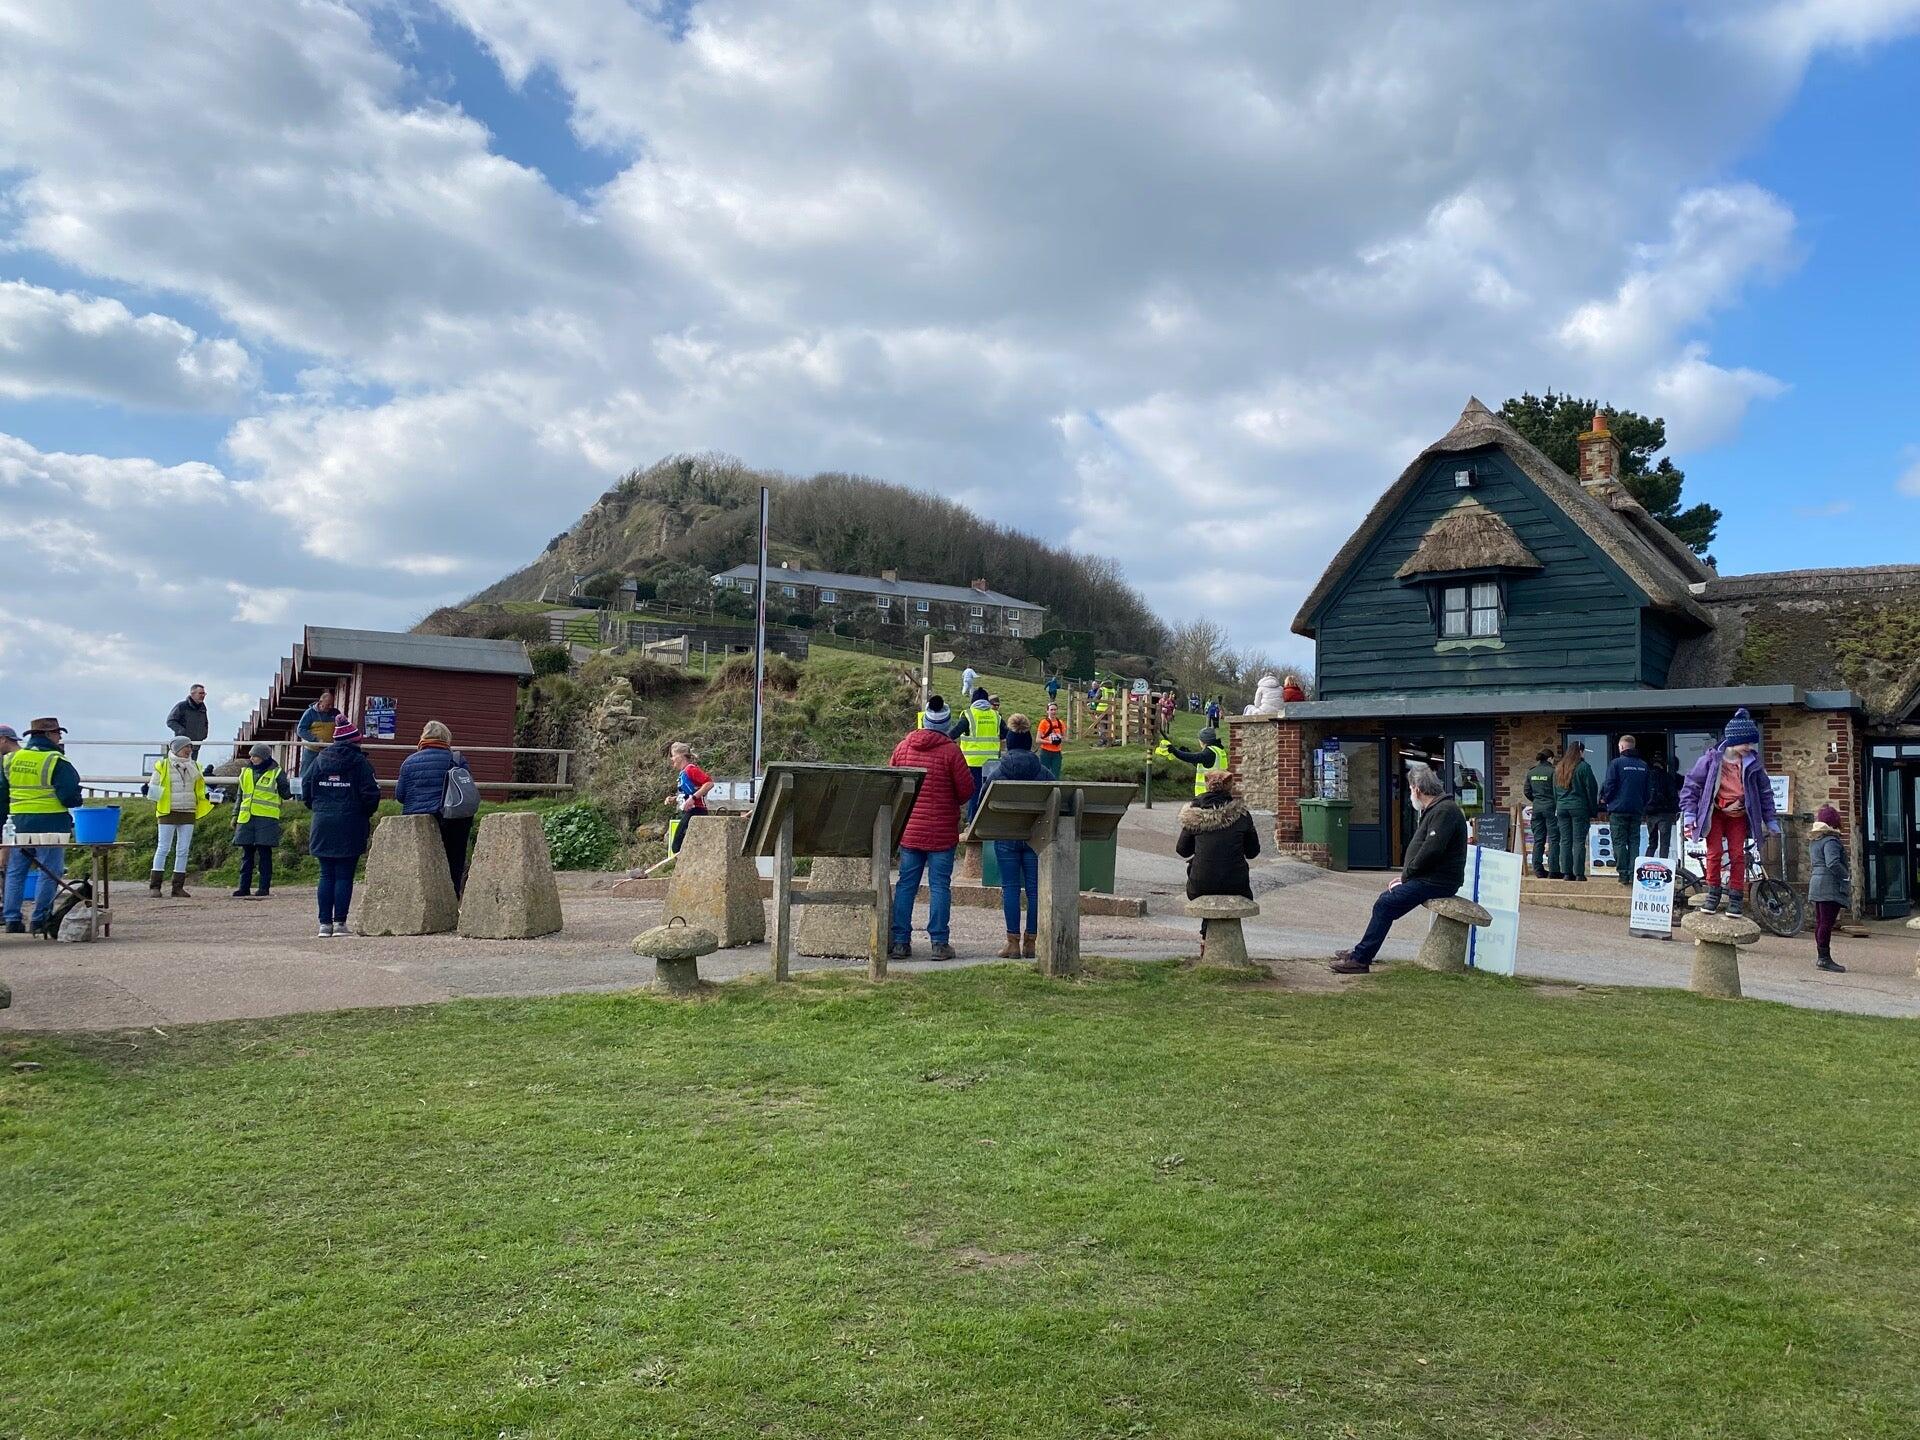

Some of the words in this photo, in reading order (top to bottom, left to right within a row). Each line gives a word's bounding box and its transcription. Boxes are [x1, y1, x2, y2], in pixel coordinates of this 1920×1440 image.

[12, 766, 39, 776] MARSHAL
[1634, 901, 1649, 912] FOR
[1650, 902, 1671, 914] DOGS
